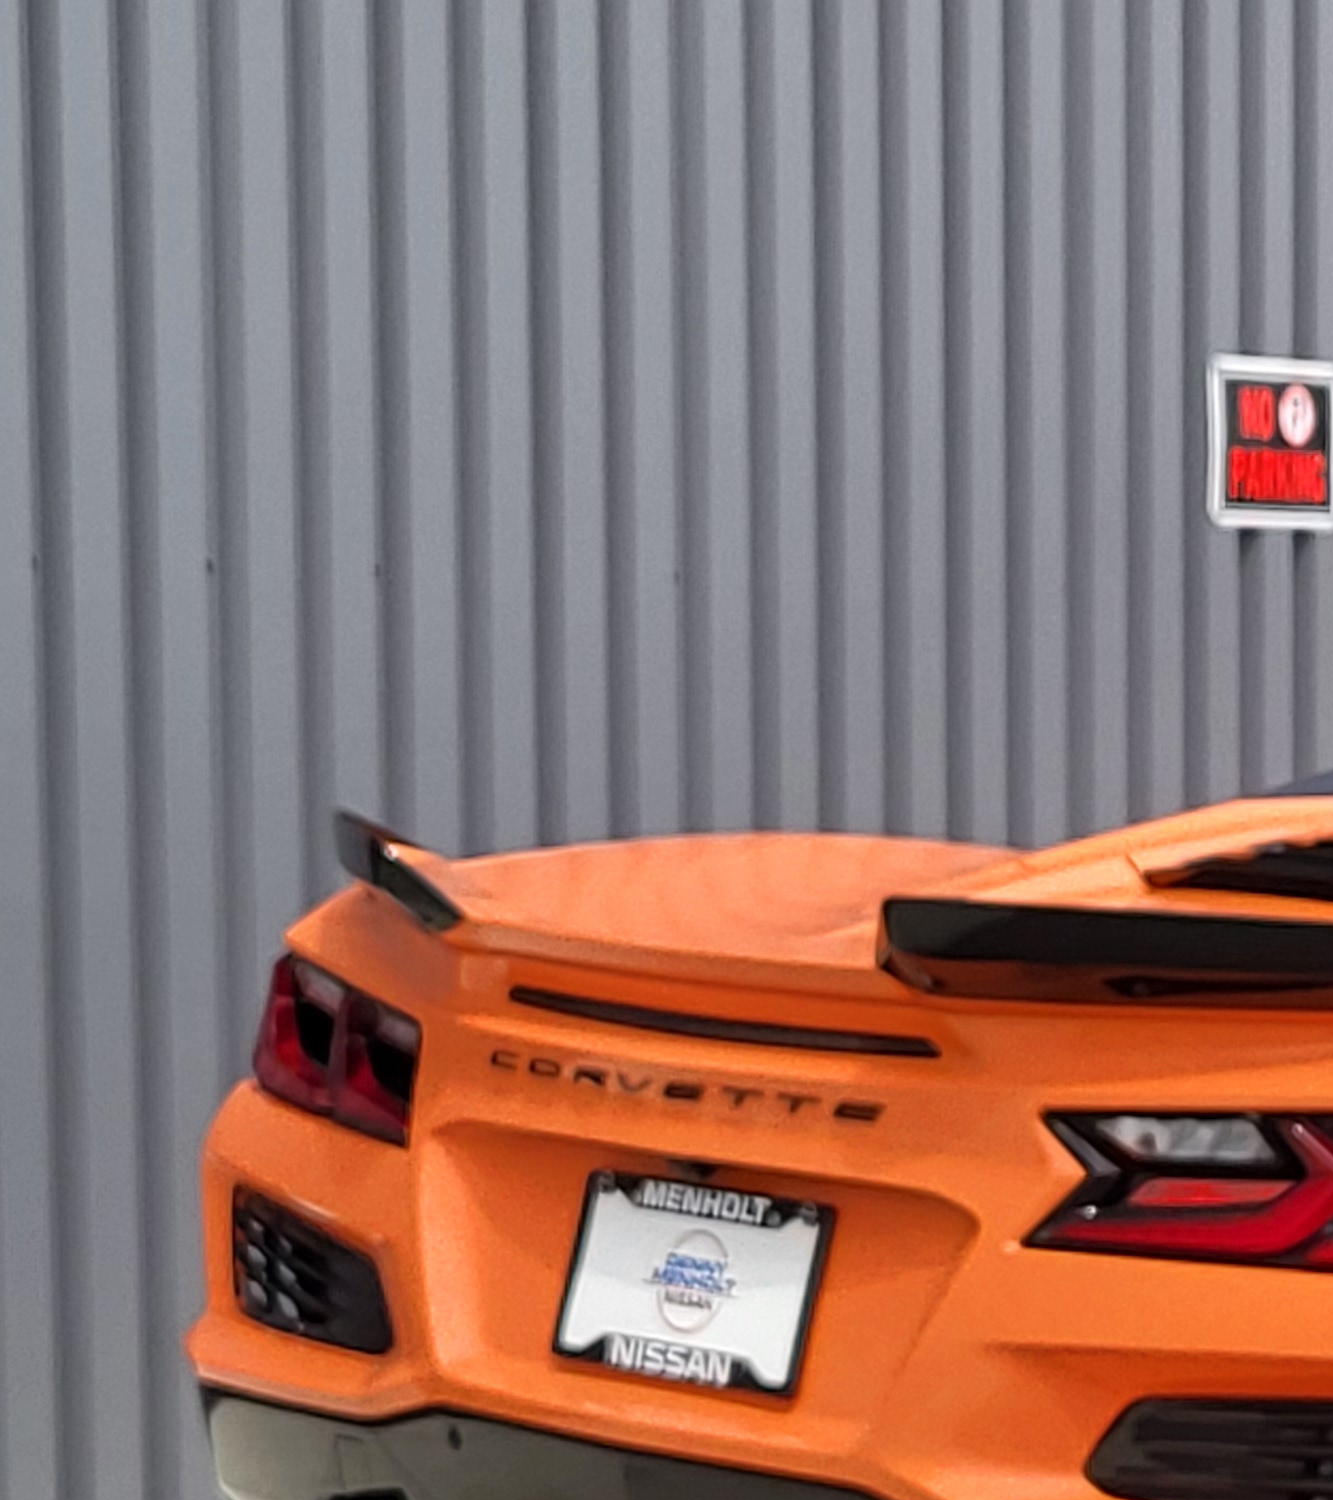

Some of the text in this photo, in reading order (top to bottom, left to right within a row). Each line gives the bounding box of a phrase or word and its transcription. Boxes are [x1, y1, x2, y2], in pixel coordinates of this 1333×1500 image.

[1239, 385, 1276, 442] NO
[1229, 446, 1327, 504] PARKING
[491, 1050, 887, 1121] CORVETTE
[642, 1179, 772, 1225] MENHOLT
[664, 1289, 713, 1310] NISSAN
[610, 1334, 733, 1386] NISSAN
